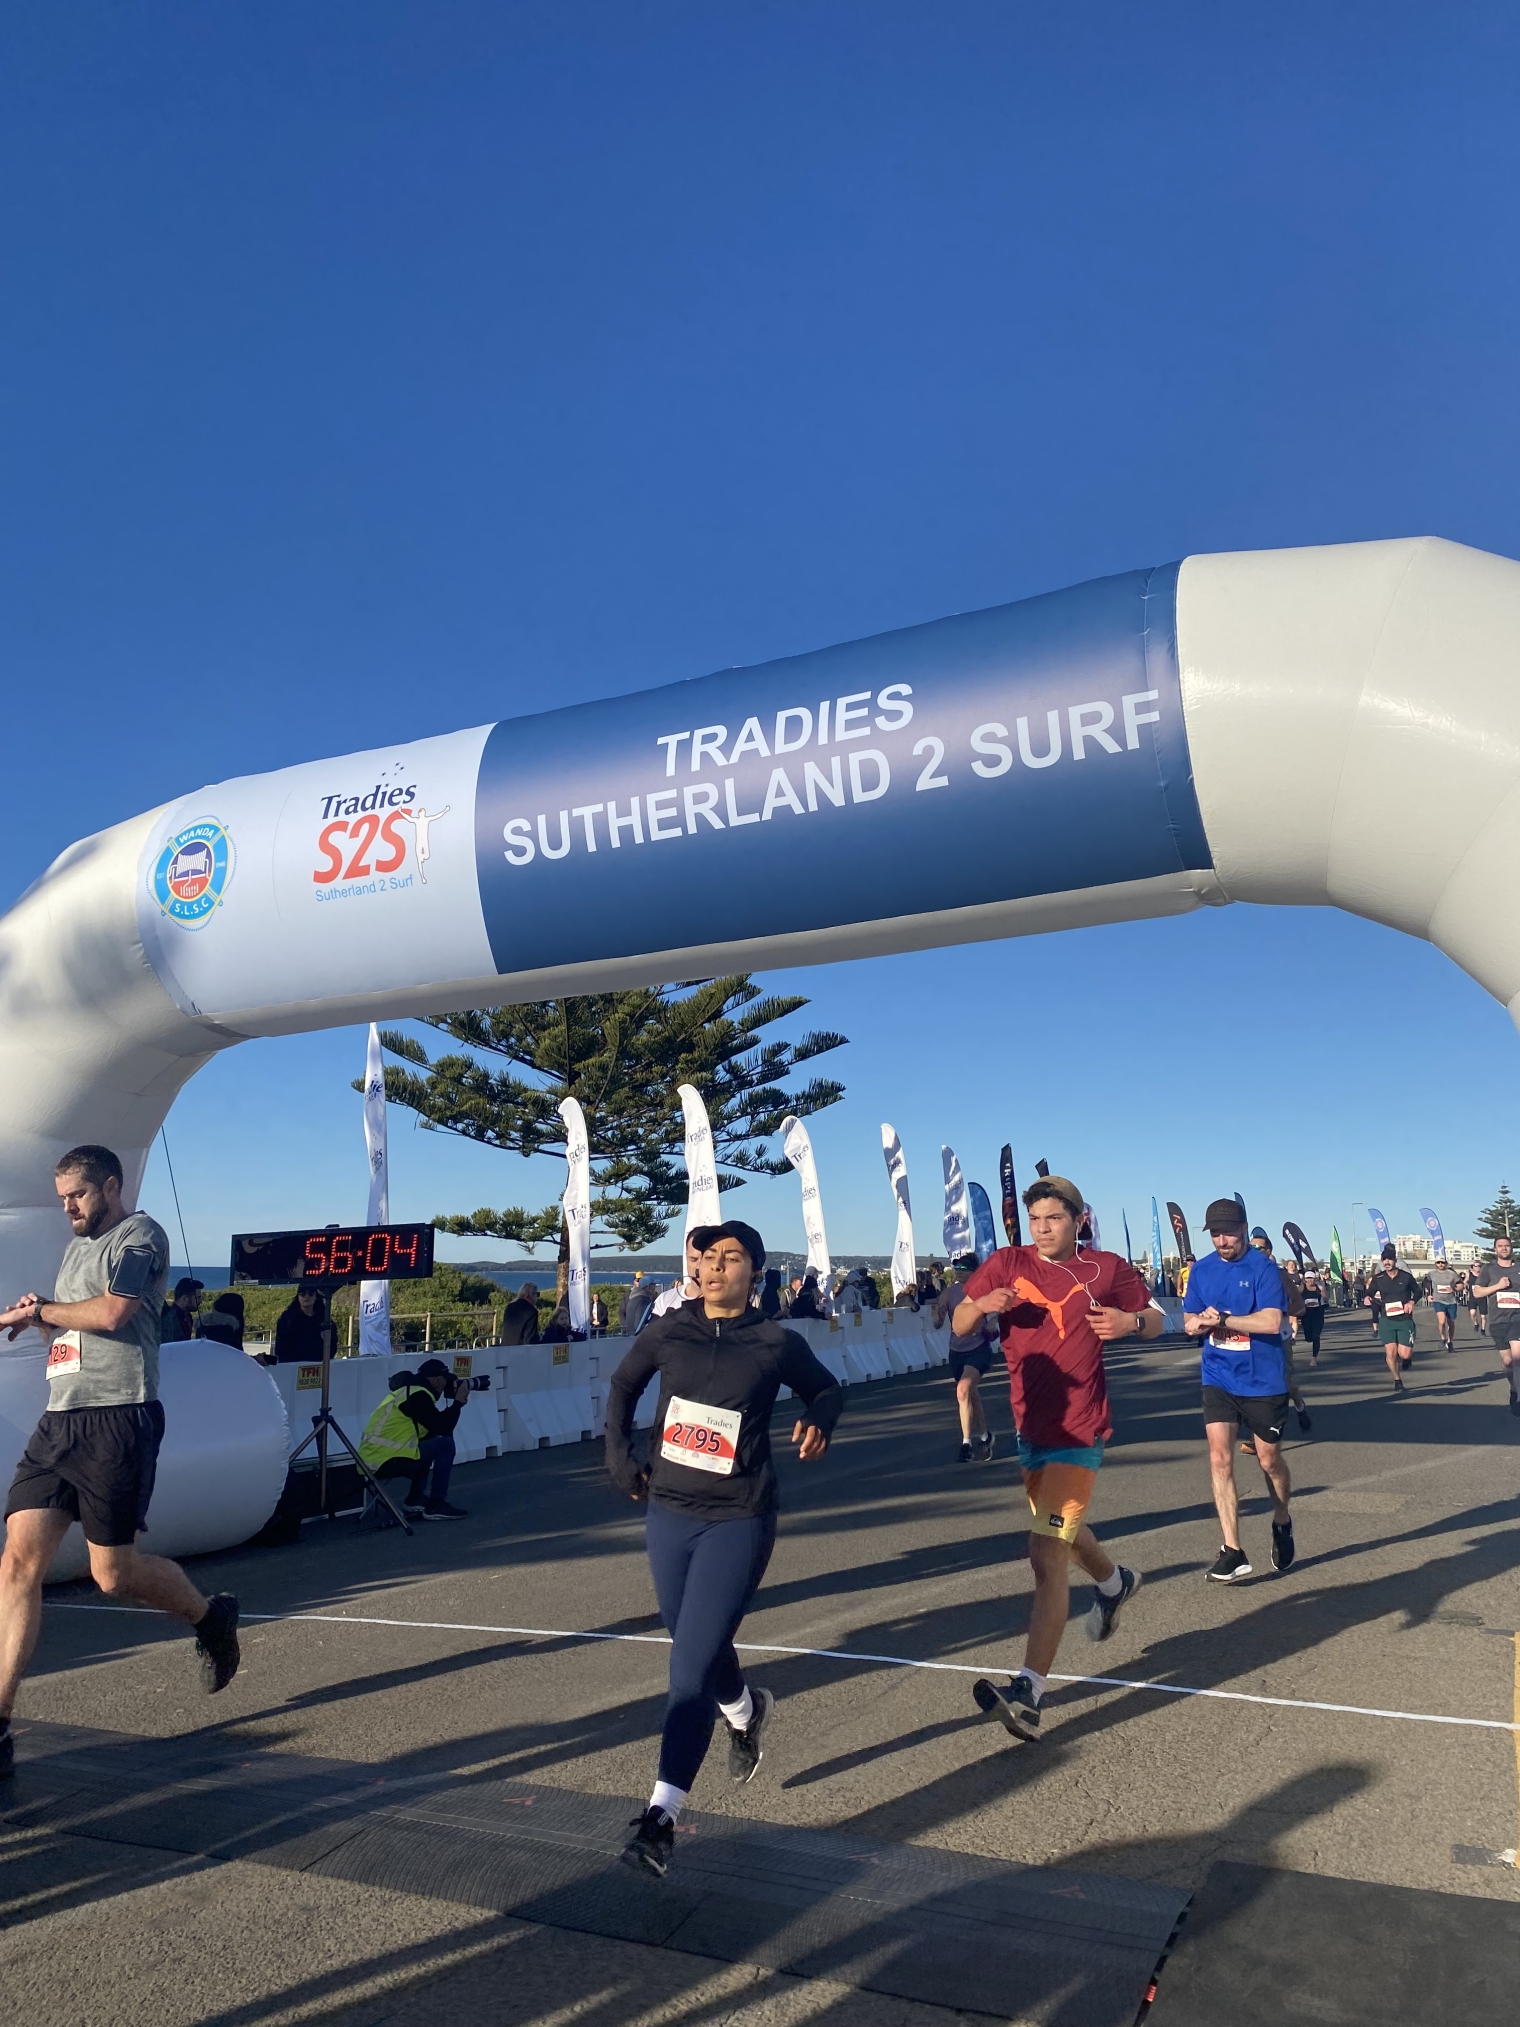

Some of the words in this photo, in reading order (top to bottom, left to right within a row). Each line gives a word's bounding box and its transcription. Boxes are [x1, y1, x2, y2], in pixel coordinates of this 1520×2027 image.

[656, 683, 914, 777] TRADIES
[503, 749, 891, 867] SUTHERLAND
[915, 737, 949, 792] 2
[970, 690, 1162, 778] SURF
[320, 784, 417, 820] Tradies
[179, 828, 215, 844] WANDA
[313, 808, 413, 884] S2S
[315, 881, 377, 902] Sutherland
[379, 879, 387, 892] 2
[390, 873, 414, 890] Surf
[301, 1366, 321, 1378] TFH
[671, 1422, 722, 1453] 2795
[706, 1416, 733, 1429] Tradies
